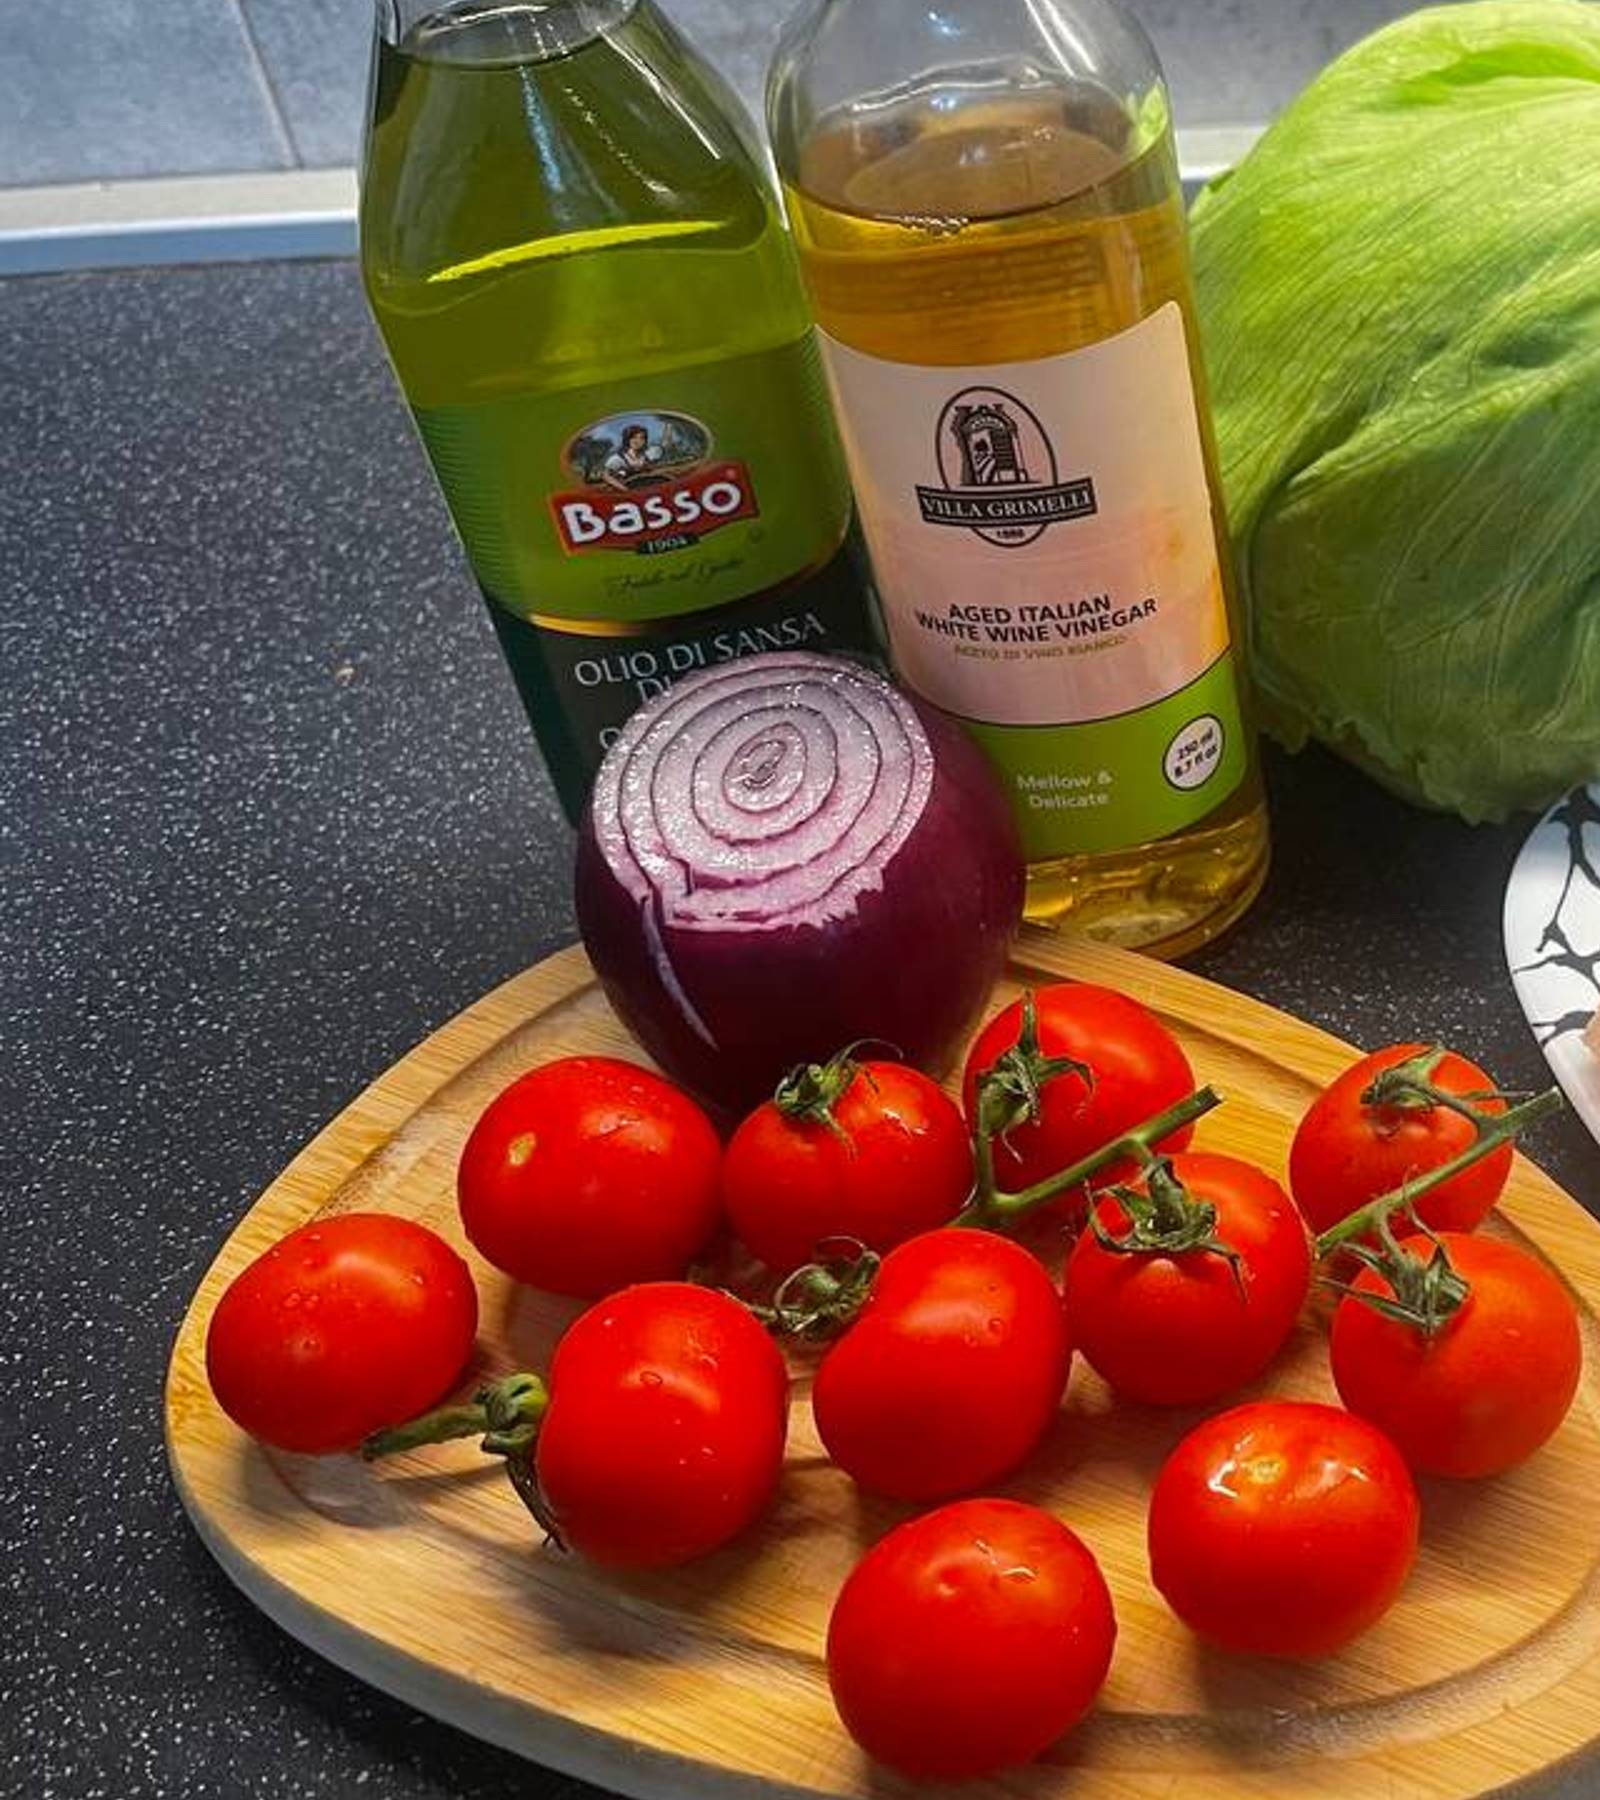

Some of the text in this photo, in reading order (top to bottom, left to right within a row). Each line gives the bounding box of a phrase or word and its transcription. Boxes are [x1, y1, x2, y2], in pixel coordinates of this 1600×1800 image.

[562, 482, 741, 543] Basso
[922, 490, 1091, 517] VILLA GRIMELLI
[915, 598, 1158, 643] WHITE WINE VINEGAR
[949, 594, 1112, 624] AGED ITALIAN
[574, 612, 826, 687] OLIO DI SANSA
[1017, 770, 1113, 790] Mellow &
[1029, 793, 1109, 809] Delicate
